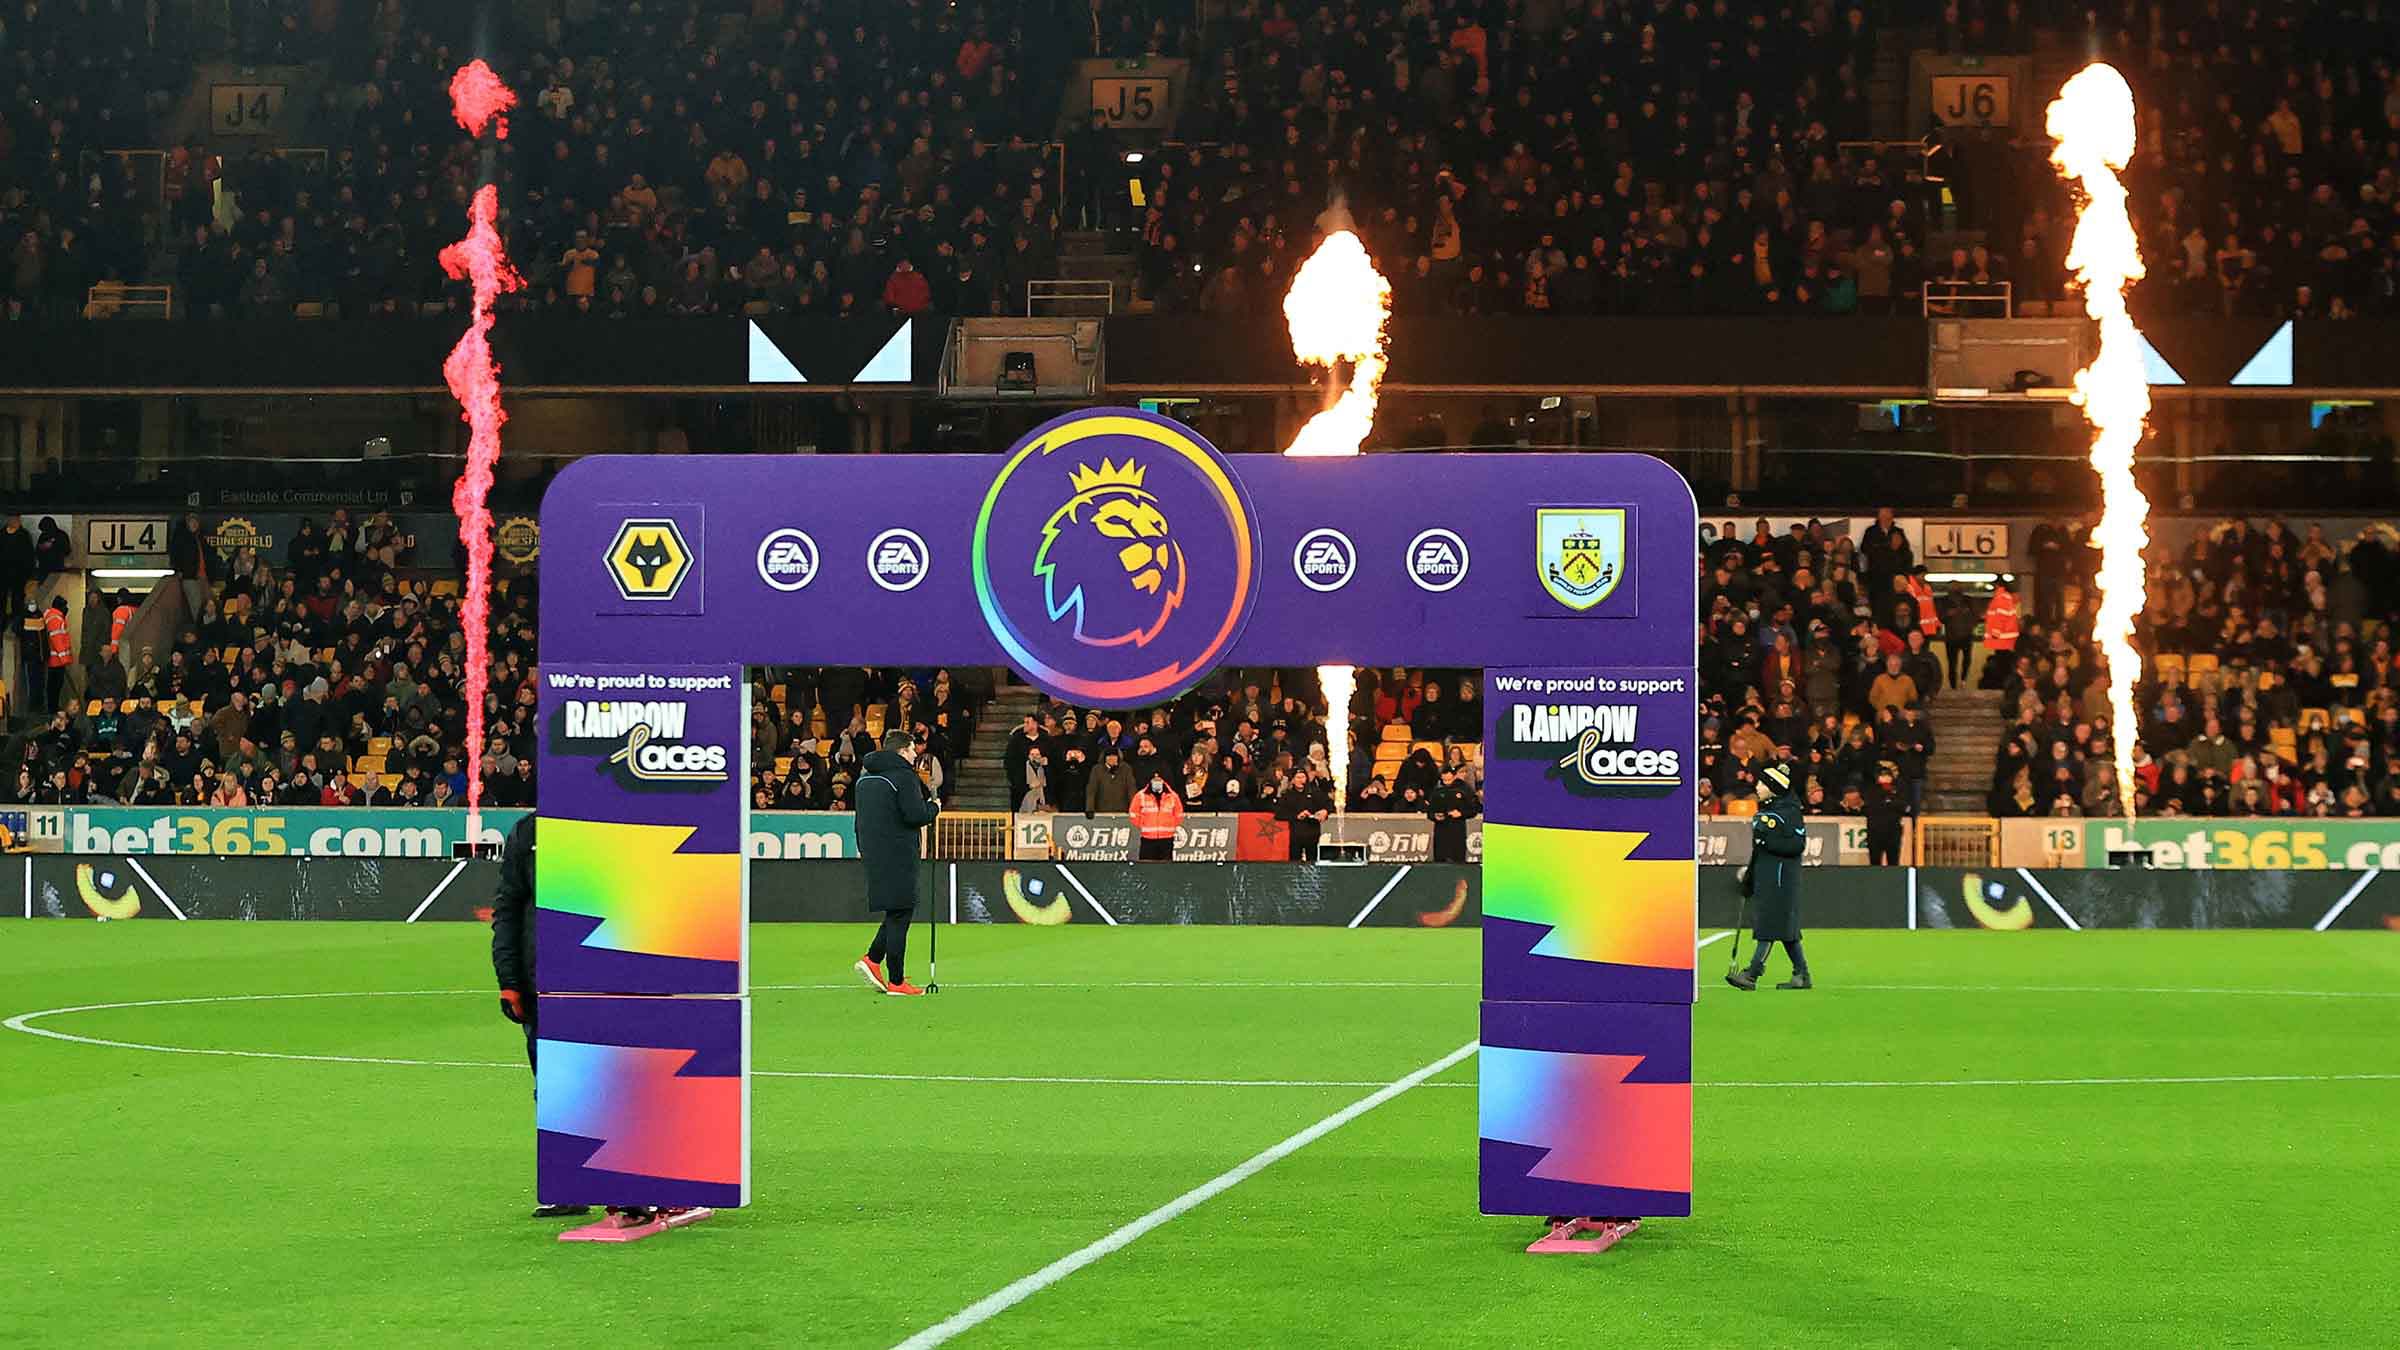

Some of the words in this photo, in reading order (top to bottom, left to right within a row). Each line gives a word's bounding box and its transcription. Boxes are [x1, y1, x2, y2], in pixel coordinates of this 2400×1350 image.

[1108, 86, 1153, 121] J5
[1947, 83, 1995, 119] J6
[768, 542, 809, 563] EA
[878, 542, 919, 563] EA
[1304, 542, 1345, 563] EA
[1417, 542, 1458, 563] EA
[767, 563, 809, 574] SPORTS
[877, 563, 919, 574] SPORTS
[1304, 563, 1346, 574] SPORTS
[1416, 563, 1458, 574] SPORTS
[549, 674, 596, 688] We're
[598, 673, 645, 691] proud
[649, 675, 666, 688] to
[668, 675, 732, 691] support
[1495, 677, 1543, 691] We're
[1546, 676, 1595, 694] proud
[1598, 678, 1617, 691] to
[1620, 678, 1685, 695] support
[37, 815, 58, 836] 11
[72, 813, 443, 857] bet365.com
[1021, 823, 1047, 845] 12
[1846, 828, 1869, 849] 12
[2047, 829, 2077, 850] 13
